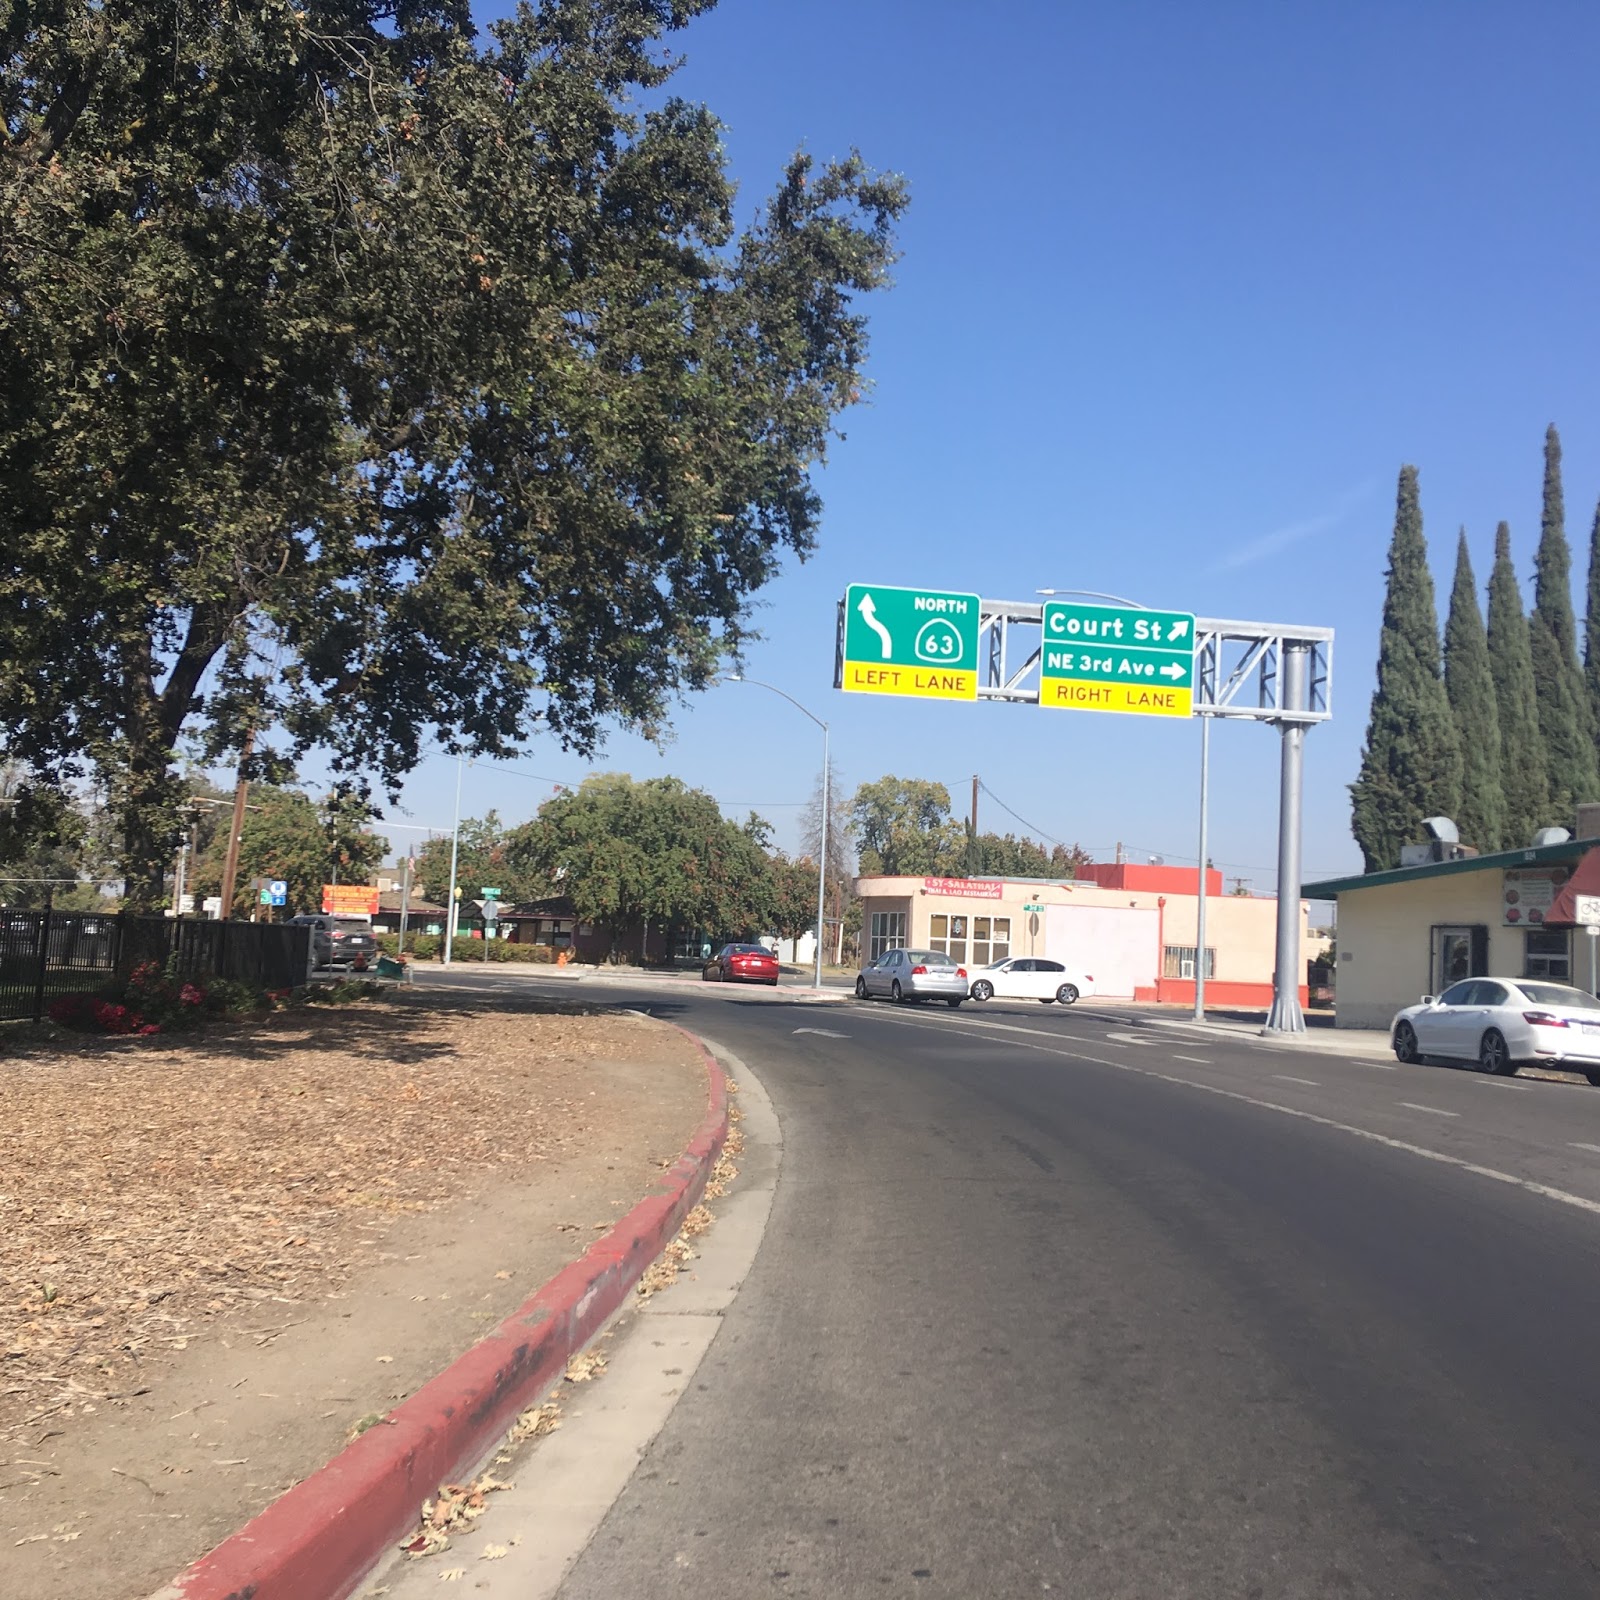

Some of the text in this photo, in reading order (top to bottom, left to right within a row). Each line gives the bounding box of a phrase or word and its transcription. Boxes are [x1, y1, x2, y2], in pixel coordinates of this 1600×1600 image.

[914, 597, 967, 614] NORTH
[1050, 612, 1161, 641] Court St
[925, 635, 953, 655] 63
[1048, 652, 1155, 676] NE 3rd Ave
[855, 669, 966, 691] LEFT LANE
[1057, 685, 1175, 708] RIGHT LANE
[963, 890, 1000, 898] RESTAURANT
